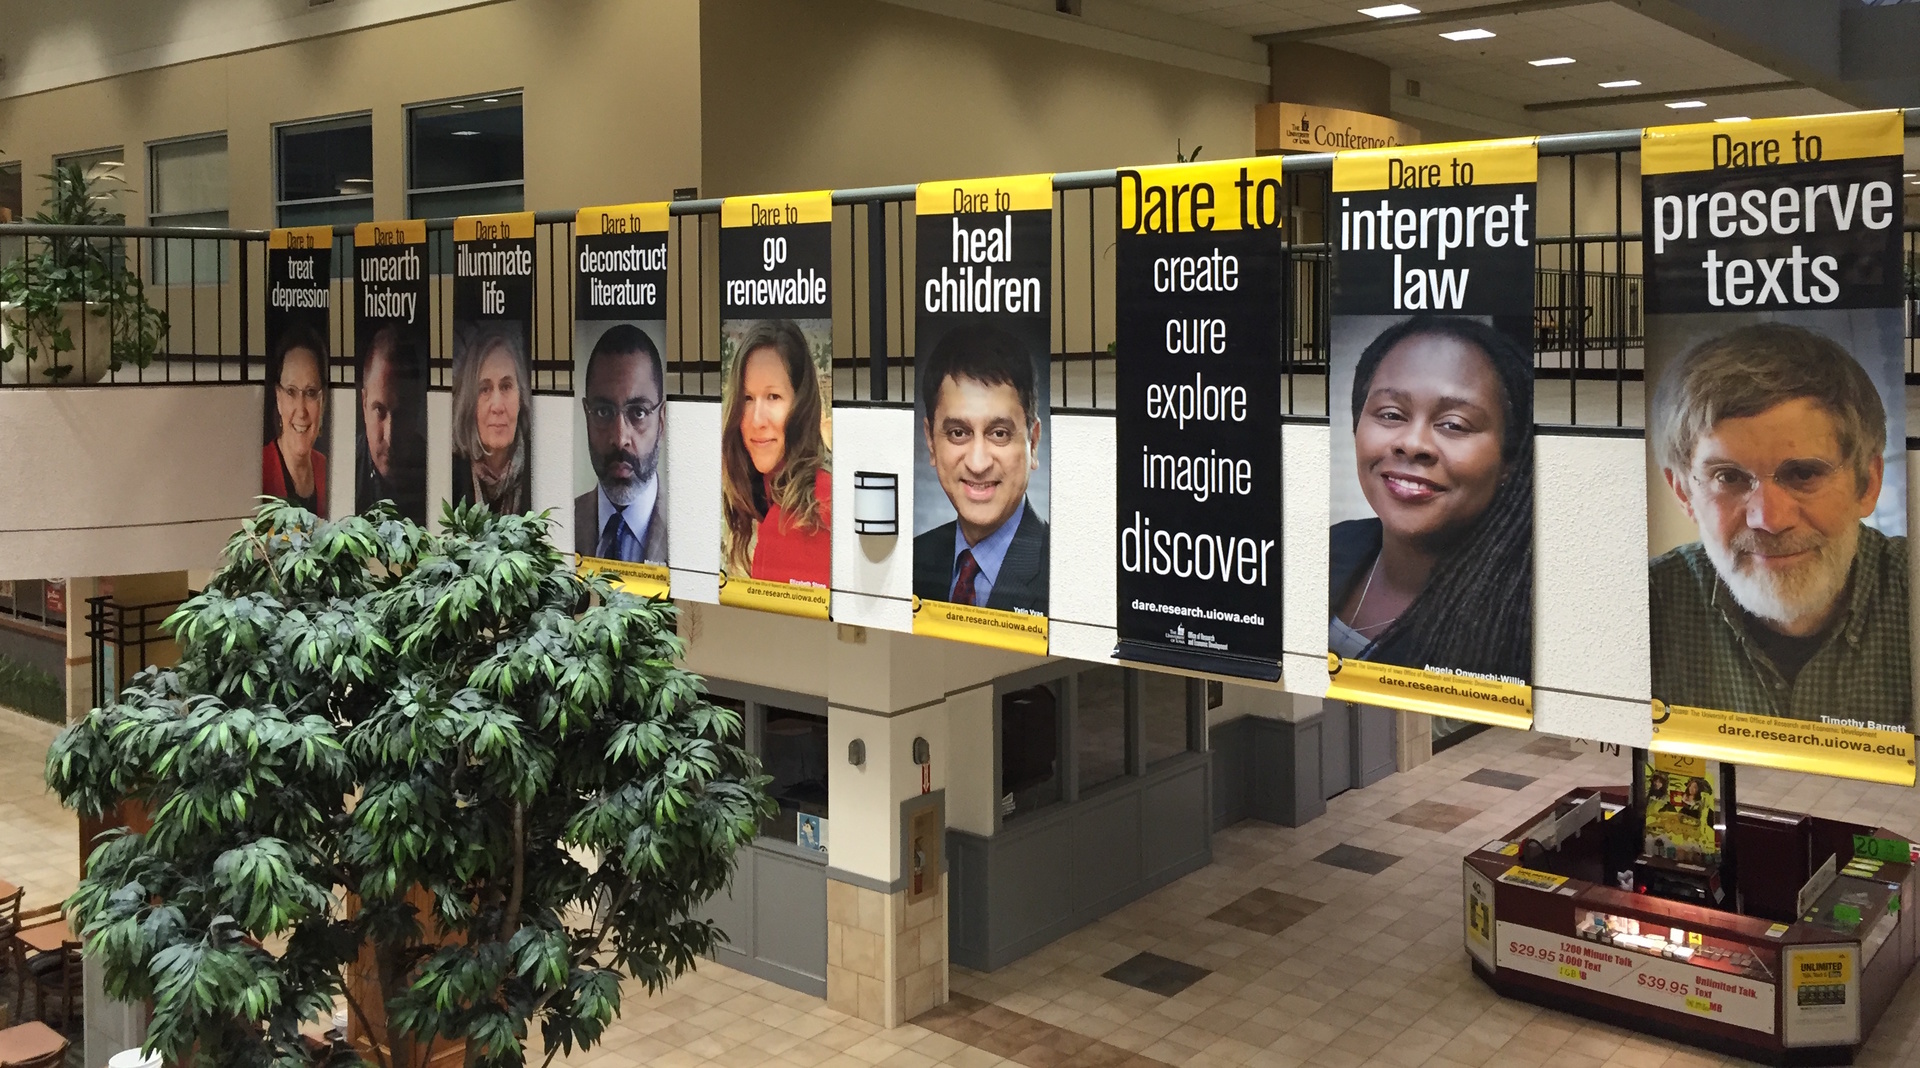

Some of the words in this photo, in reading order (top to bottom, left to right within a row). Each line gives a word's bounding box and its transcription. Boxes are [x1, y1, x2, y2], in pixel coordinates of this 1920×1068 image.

[1314, 125, 1385, 149] Conference
[1712, 133, 1780, 170] Dare
[1792, 130, 1822, 164] to
[1389, 158, 1441, 189] Dare
[1450, 157, 1474, 186] to
[751, 203, 781, 227] Dare
[785, 203, 798, 226] to
[953, 188, 989, 214] Dare
[996, 188, 1011, 213] to
[1119, 169, 1215, 234] Dare
[1234, 167, 1282, 230] to
[475, 220, 498, 241] Dare
[500, 221, 510, 240] to
[601, 213, 626, 235] Dare
[629, 214, 641, 233] to
[1341, 193, 1529, 261] interpret
[1654, 180, 1893, 254] preserve
[286, 231, 304, 249] Dare
[306, 233, 314, 249] to
[373, 227, 393, 246] Dare
[396, 228, 405, 245] to
[952, 214, 1012, 263] heal
[288, 255, 314, 280] treat
[360, 246, 420, 282] unearth
[457, 243, 532, 277] illuminate
[580, 243, 667, 273] deconstruct
[763, 235, 787, 272] go
[1153, 247, 1239, 293] create
[1393, 254, 1469, 310] law
[1702, 245, 1840, 307] texts
[272, 281, 329, 312] depression
[482, 280, 505, 315] life
[590, 277, 656, 306] literature
[726, 267, 826, 305] renewable
[925, 265, 1041, 313] children
[364, 284, 417, 324] history
[1165, 317, 1226, 355] cure
[1146, 371, 1247, 430] explore
[1143, 445, 1252, 502] imagine
[1121, 510, 1275, 587] discover
[747, 586, 826, 604] dare.research.uiowa.edu
[945, 611, 1043, 634] dare.research.uiowa.edu
[1131, 598, 1265, 626] dare.research.uiowa.edu
[1424, 663, 1453, 675] Angela
[1455, 668, 1526, 687] Onwuachi-Willig
[1379, 675, 1525, 706] dare.research.uiowa.edu
[1820, 715, 1865, 729] Timothy
[1867, 720, 1906, 734] Barrett
[1717, 723, 1906, 757] dare.research.uiowa.edu
[1855, 837, 1879, 856] 20
[1509, 941, 1556, 962] $29.95
[1583, 947, 1613, 963] Minute
[1615, 955, 1633, 968] Talk
[1584, 959, 1601, 972] Text
[1800, 962, 1843, 972] UNLIMITED
[1637, 973, 1689, 996] $39.95
[1695, 975, 1737, 994] Unlimited
[1695, 987, 1712, 999] Text
